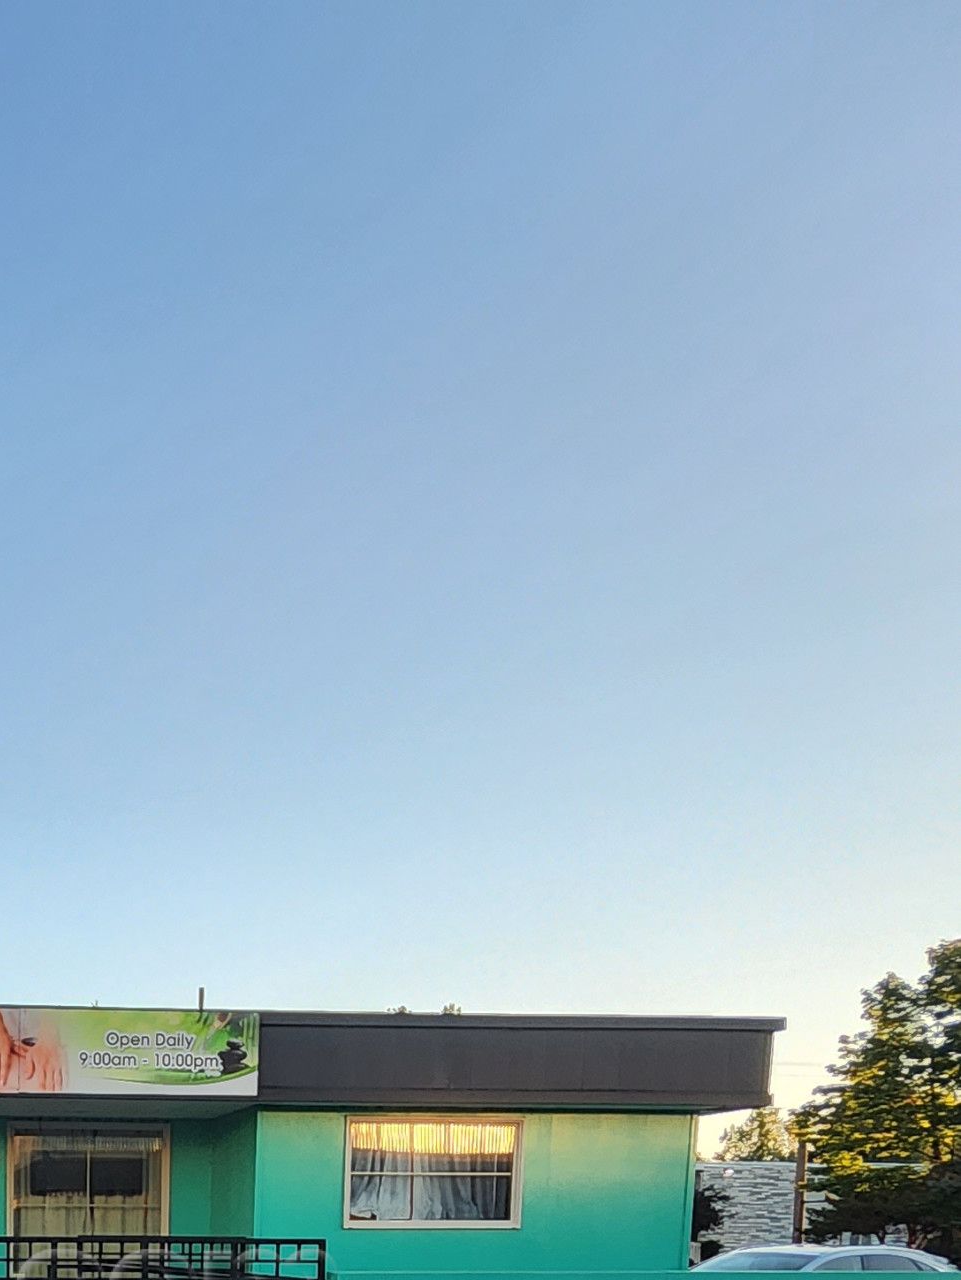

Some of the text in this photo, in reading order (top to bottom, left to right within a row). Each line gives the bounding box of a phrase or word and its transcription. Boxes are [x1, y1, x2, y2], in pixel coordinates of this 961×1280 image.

[106, 1032, 195, 1049] Open Daily
[79, 1052, 137, 1067] 9:00am
[154, 1053, 219, 1069] 10:00pm
